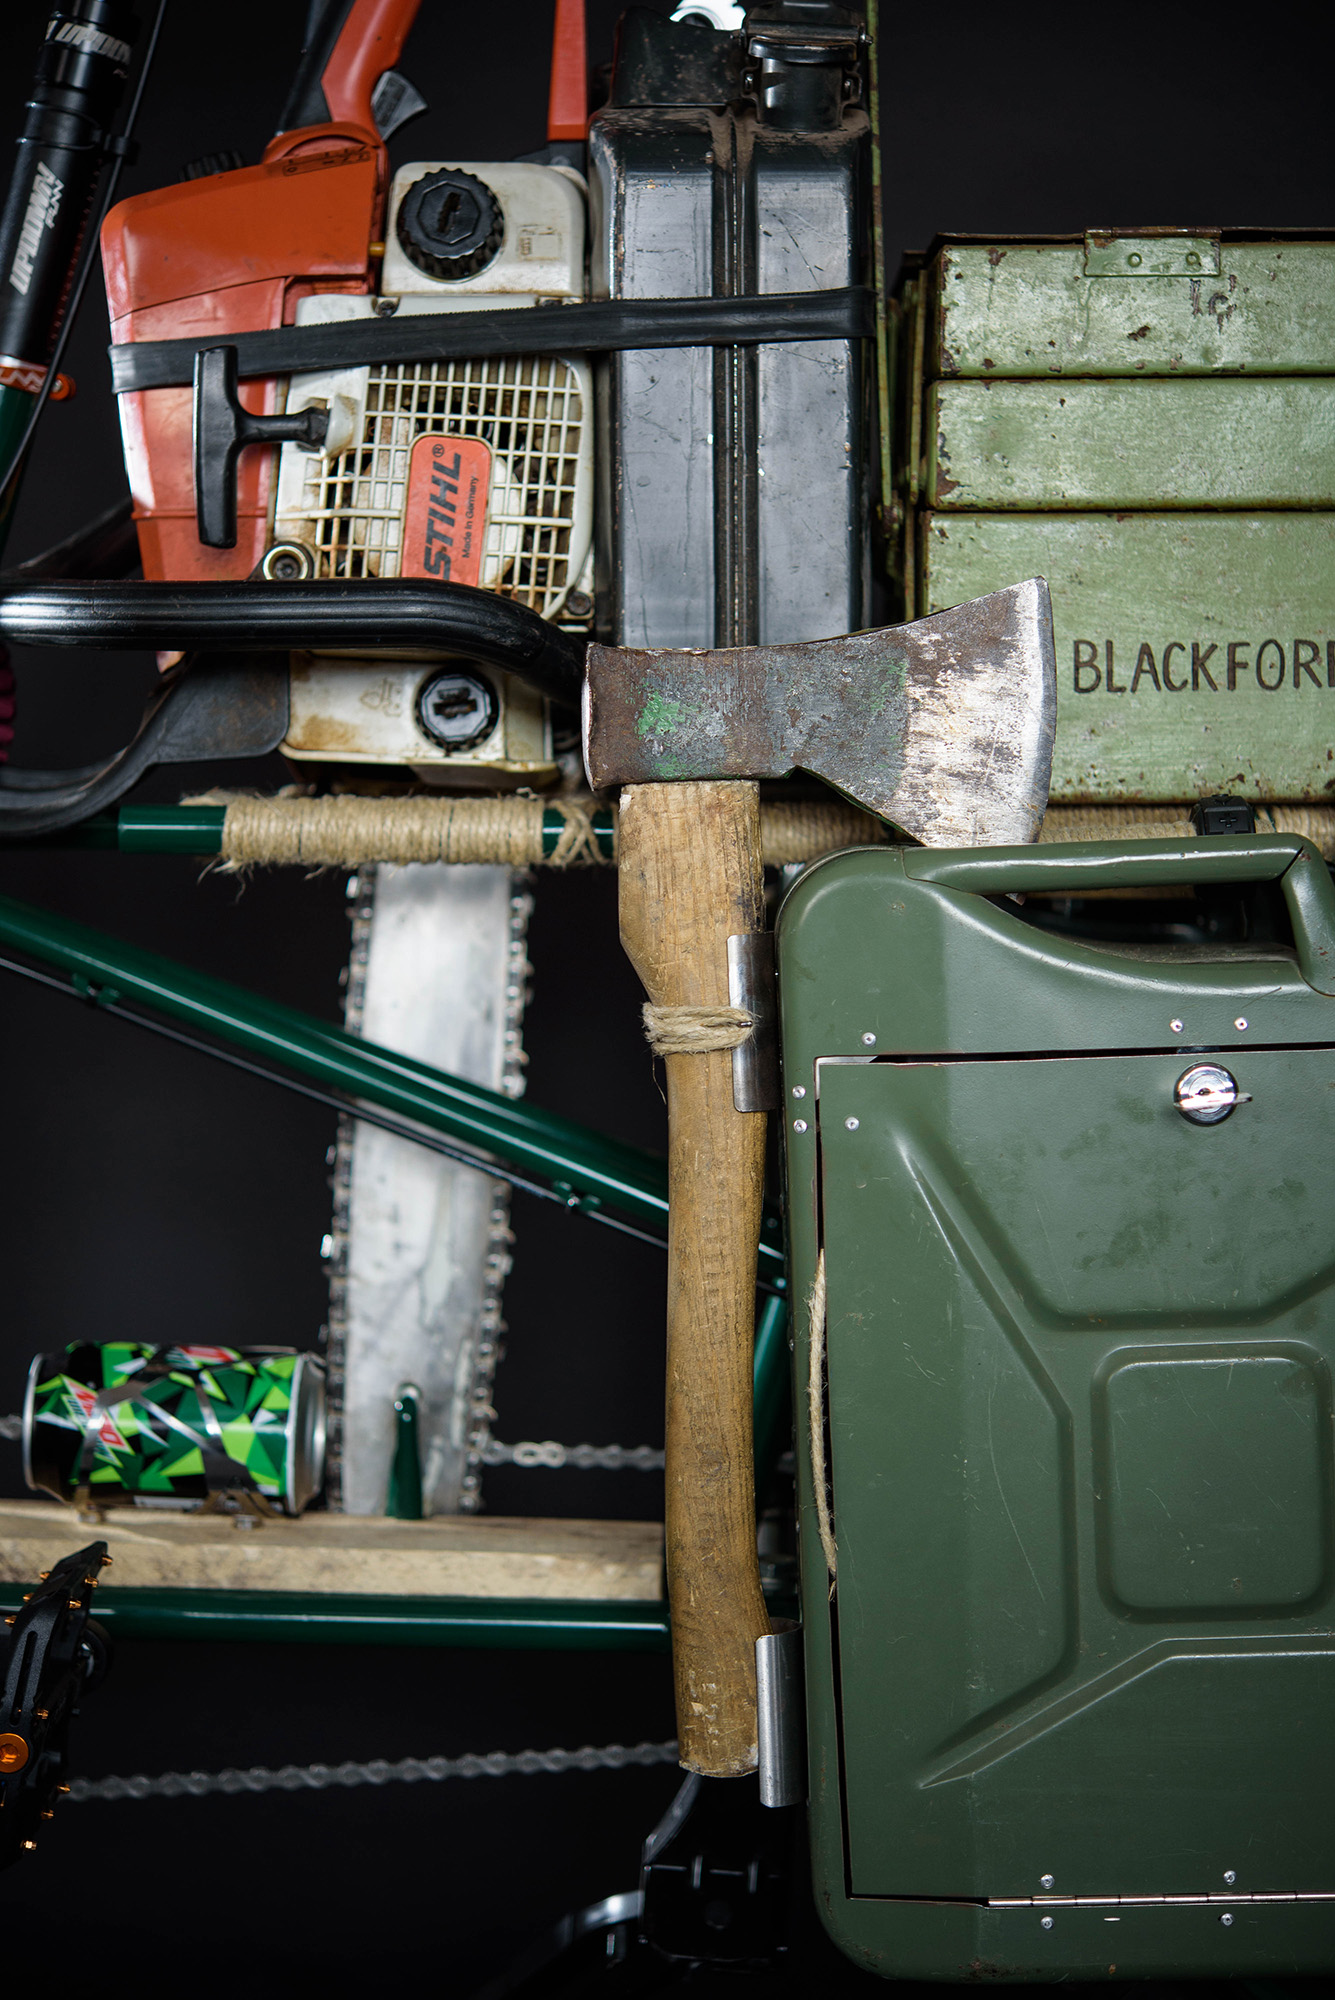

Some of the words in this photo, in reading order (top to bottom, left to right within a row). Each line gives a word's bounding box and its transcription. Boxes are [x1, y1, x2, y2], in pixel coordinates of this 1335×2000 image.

[9, 161, 56, 295] UPDOWN
[466, 476, 479, 518] Germany
[462, 532, 472, 558] Made
